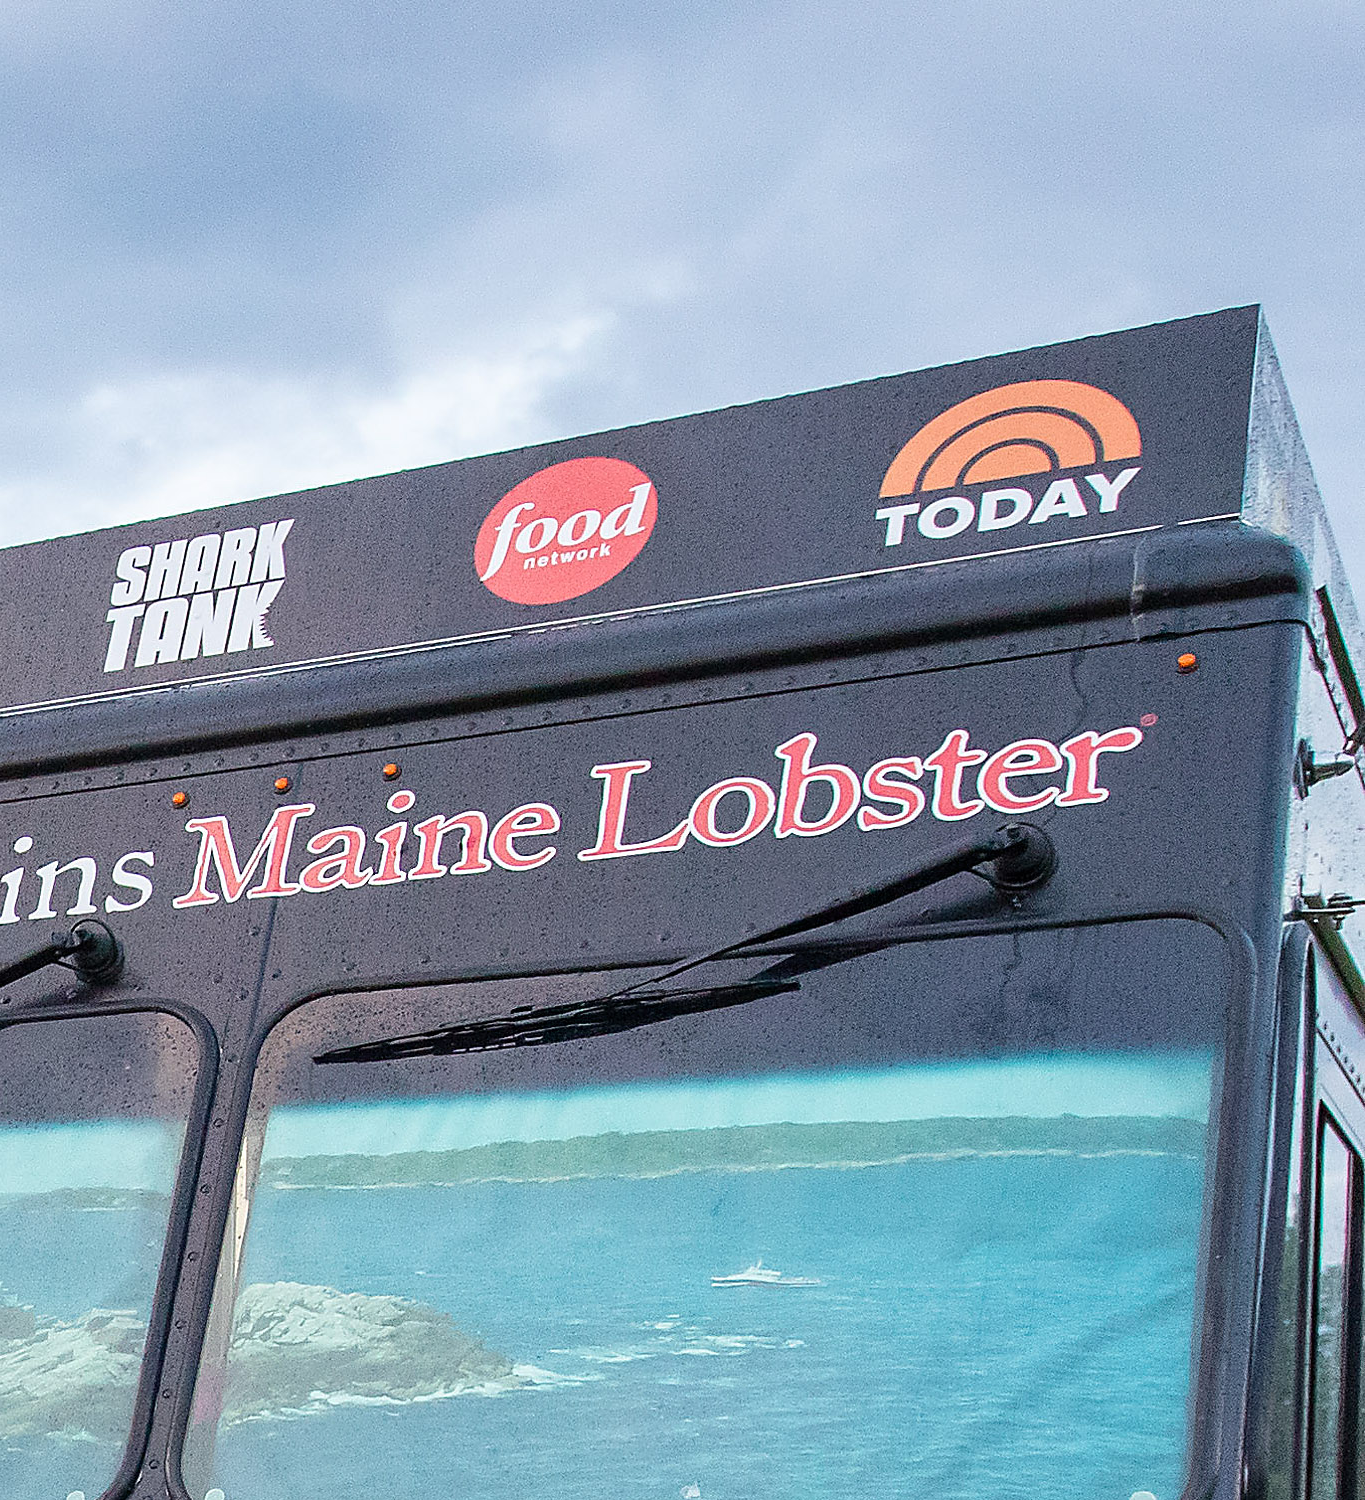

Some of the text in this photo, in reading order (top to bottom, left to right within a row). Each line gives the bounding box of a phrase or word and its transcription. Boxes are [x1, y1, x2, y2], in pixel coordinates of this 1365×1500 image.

[479, 481, 652, 582] food
[875, 467, 1142, 547] TODAY
[110, 518, 295, 607] SHARK
[523, 542, 612, 570] network
[103, 579, 286, 673] TANK
[172, 789, 561, 909] Maine
[576, 726, 1144, 862] Lobster
